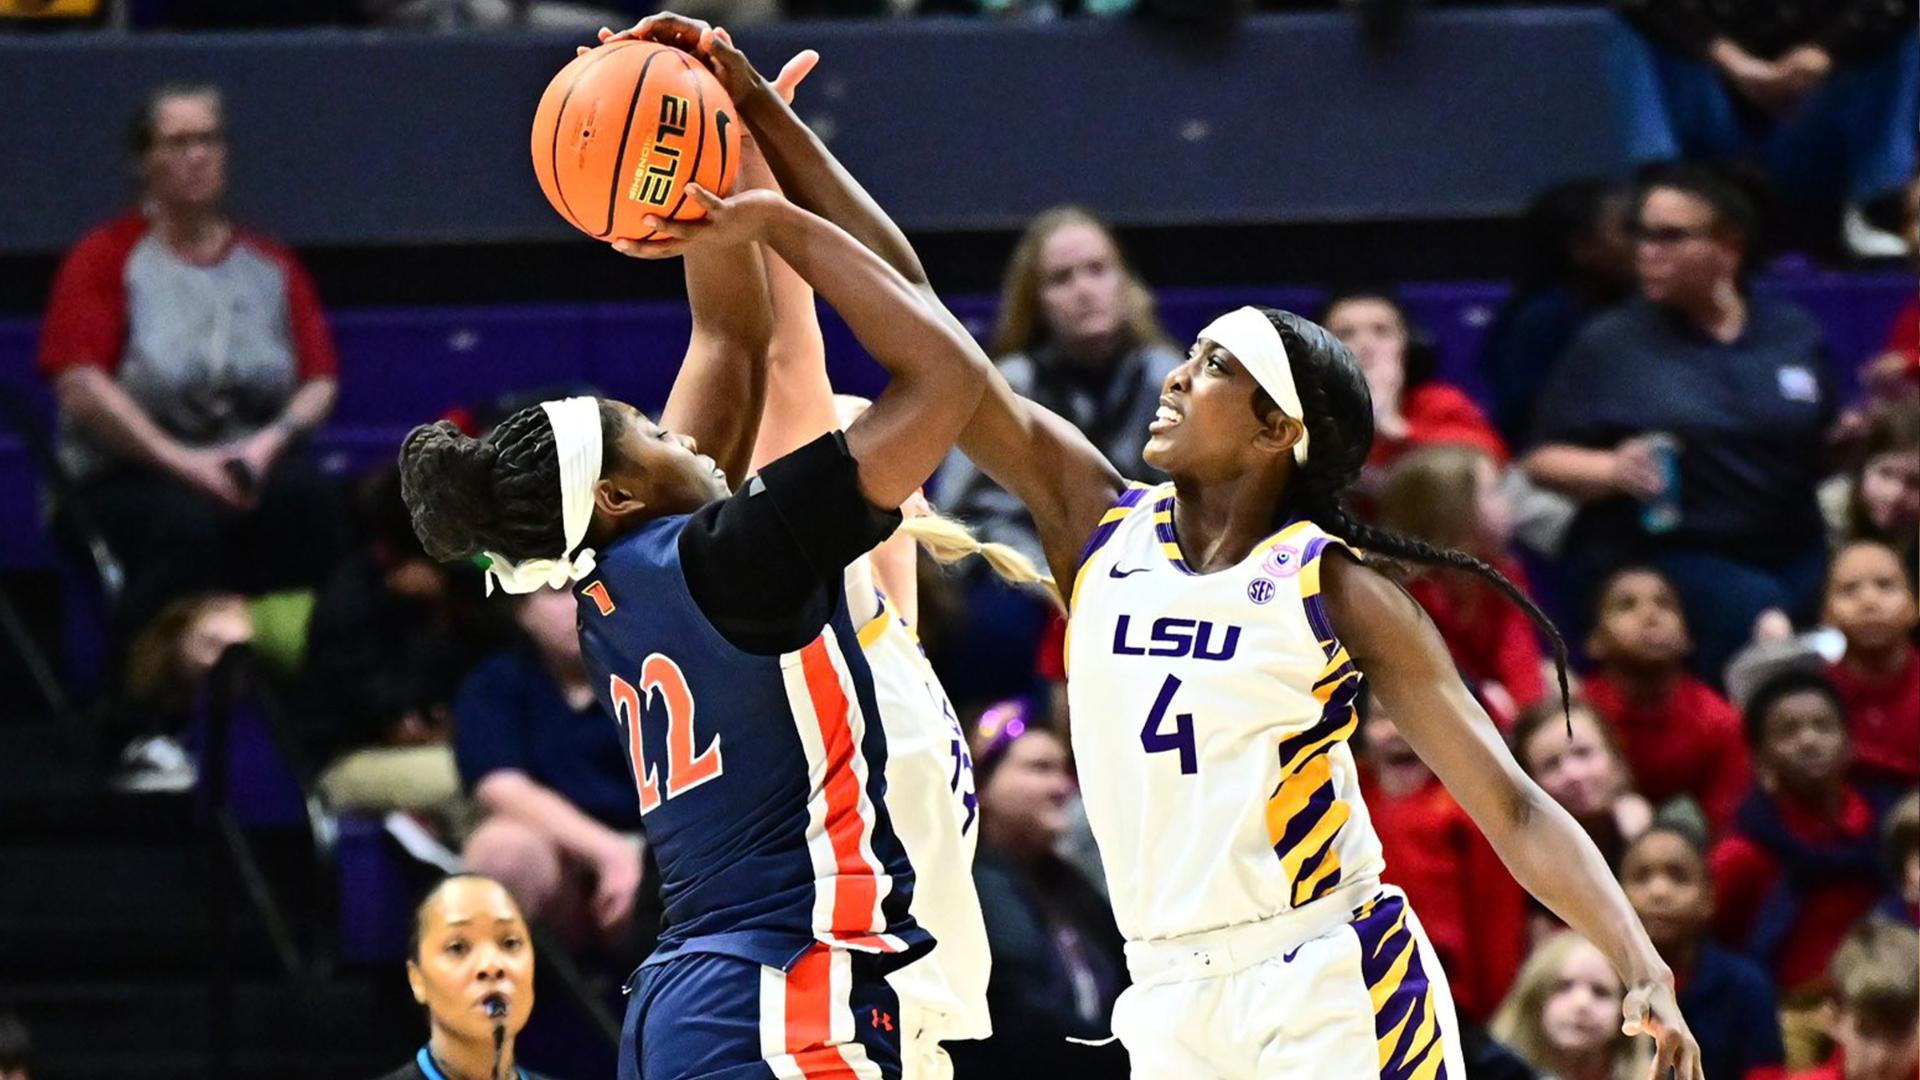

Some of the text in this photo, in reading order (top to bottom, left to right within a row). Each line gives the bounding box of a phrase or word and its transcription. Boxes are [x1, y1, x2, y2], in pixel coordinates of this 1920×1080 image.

[639, 94, 690, 206] ELITE
[1112, 614, 1242, 661] LSU
[1249, 579, 1274, 602] SEC
[609, 652, 723, 816] 22
[1140, 673, 1198, 775] 4
